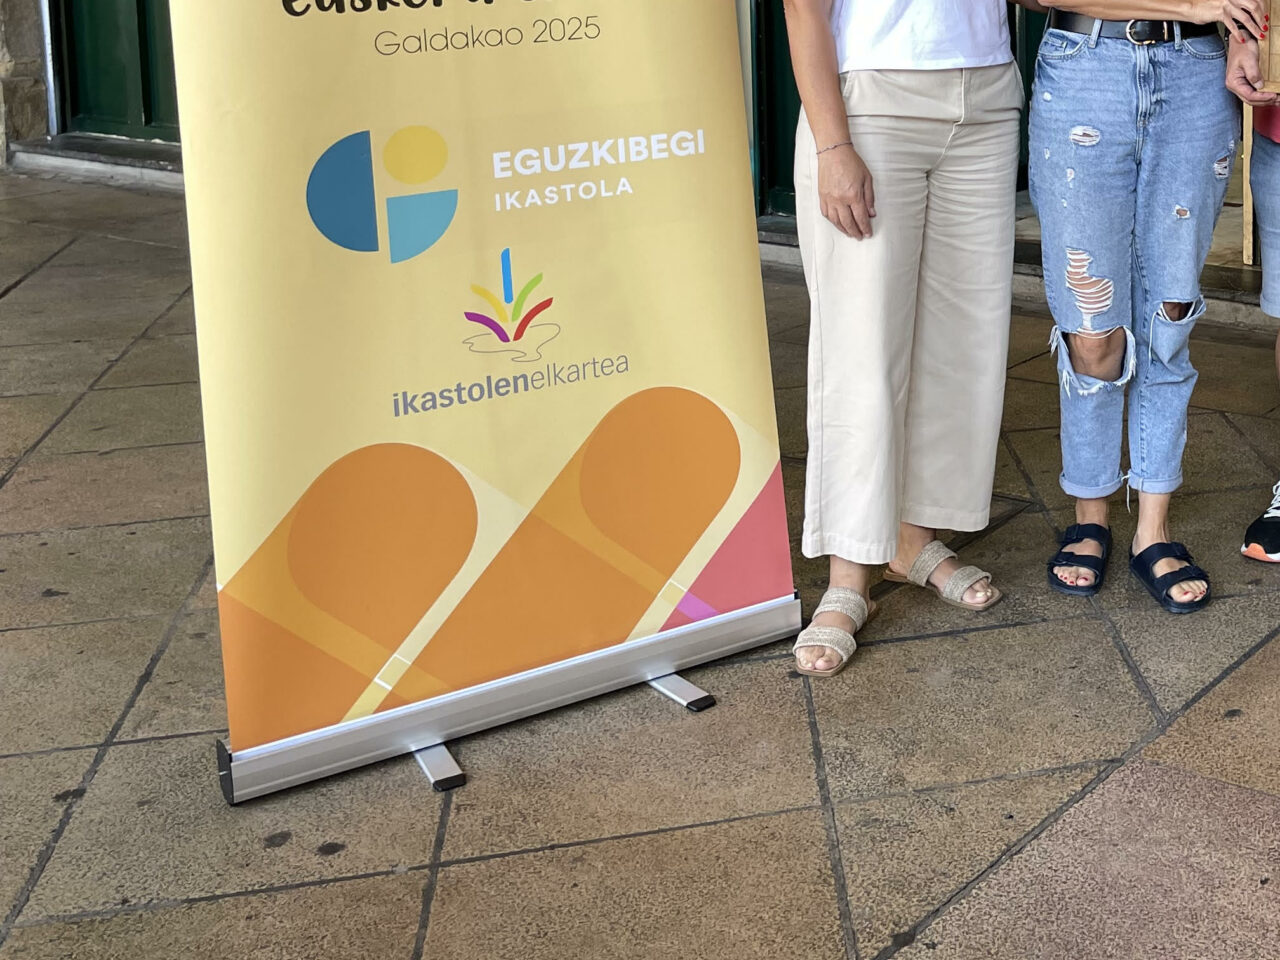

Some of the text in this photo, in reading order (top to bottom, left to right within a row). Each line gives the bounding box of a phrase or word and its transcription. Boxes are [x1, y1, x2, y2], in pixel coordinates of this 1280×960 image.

[374, 15, 601, 56] Galdakao 2025
[492, 129, 706, 179] EGUZKIBEGI
[494, 177, 633, 212] IKASTOLA
[392, 354, 630, 418] ikastolenelkartea
